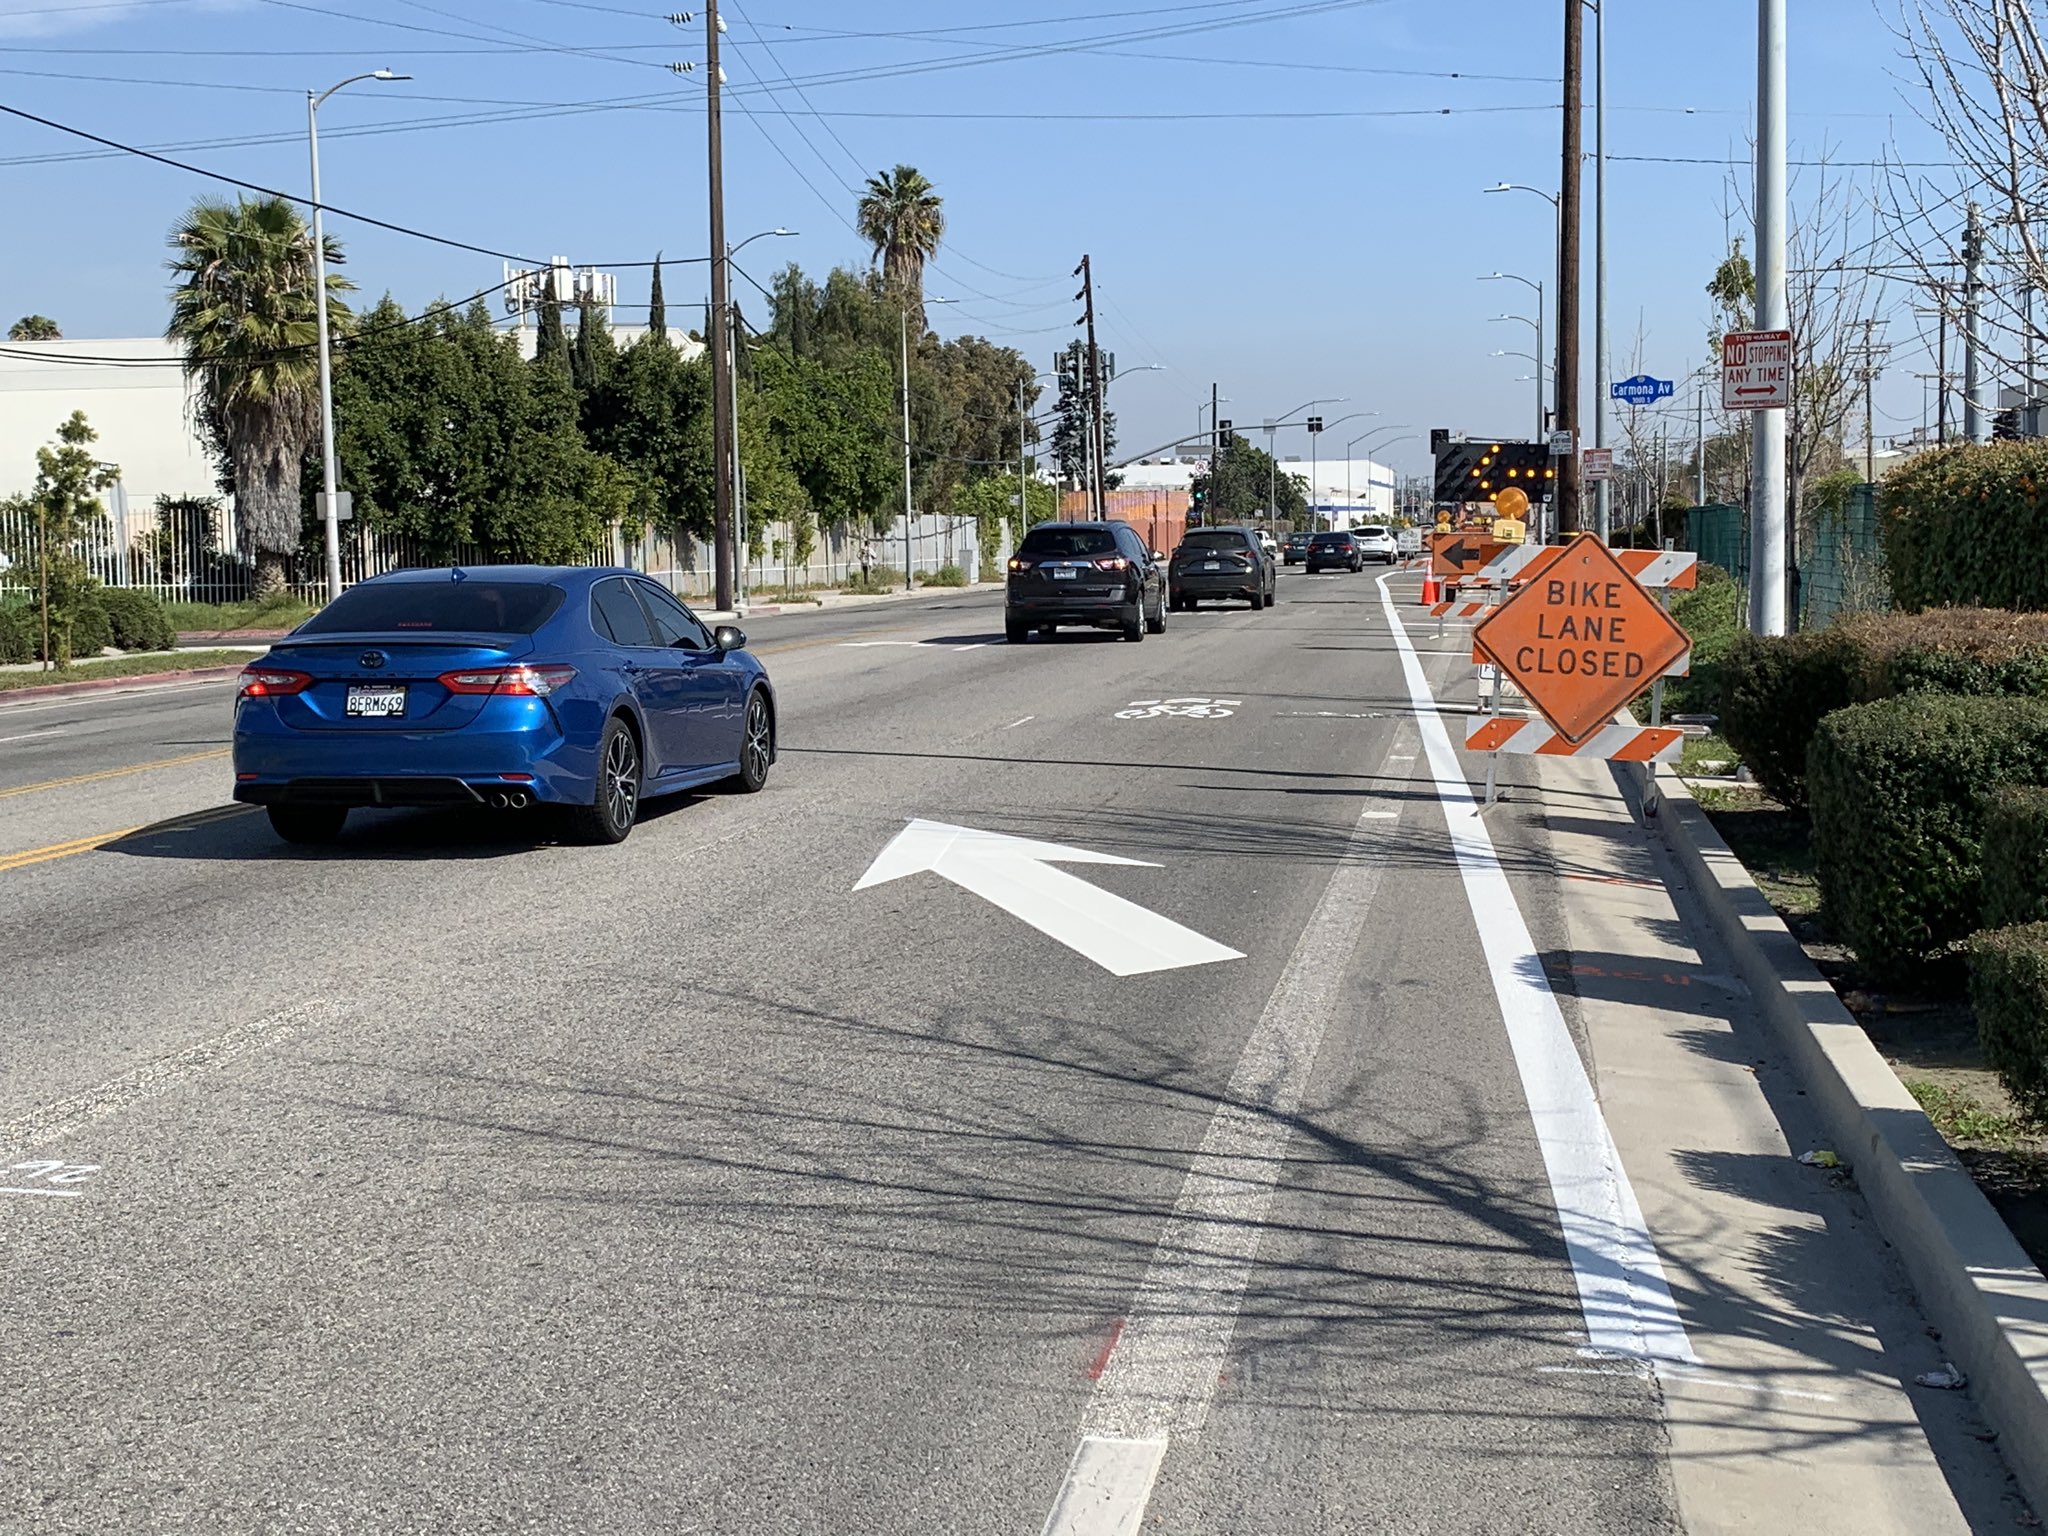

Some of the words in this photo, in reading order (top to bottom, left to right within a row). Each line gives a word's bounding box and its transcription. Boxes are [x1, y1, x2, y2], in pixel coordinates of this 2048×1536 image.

[1726, 344, 1745, 365] NO
[1749, 345, 1787, 363] STOPPING
[1728, 368, 1751, 383] ANY
[1757, 367, 1785, 382] TIME
[1612, 384, 1653, 396] Carmona
[1658, 383, 1670, 394] Av
[1547, 580, 1621, 608] BIKE
[1538, 613, 1626, 643] LANE
[1516, 646, 1644, 678] CLOSED
